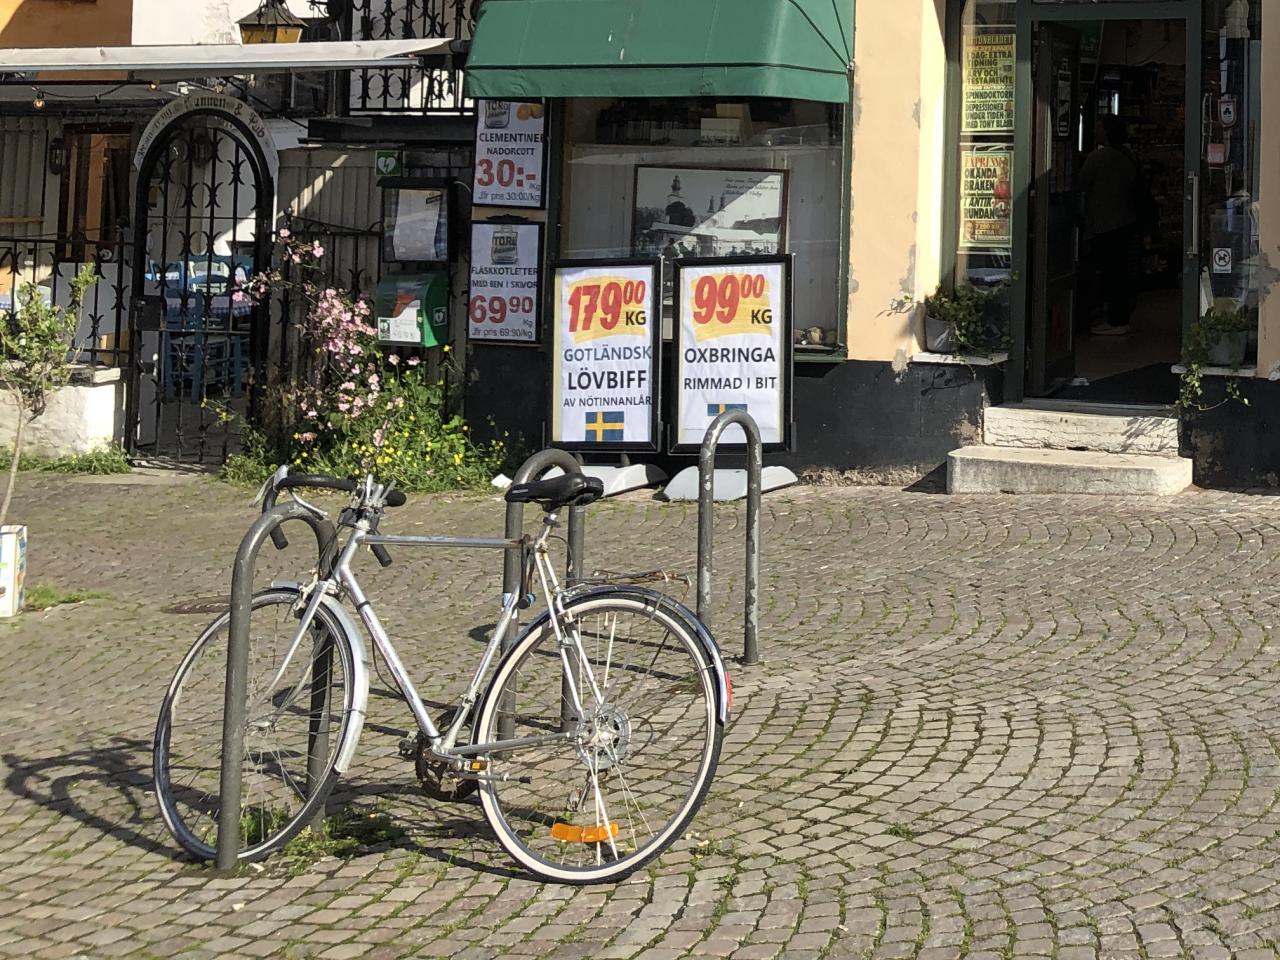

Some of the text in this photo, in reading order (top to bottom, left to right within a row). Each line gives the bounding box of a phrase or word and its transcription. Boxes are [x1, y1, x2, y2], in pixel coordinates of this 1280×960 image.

[989, 50, 1013, 59] EXTRA
[984, 69, 999, 77] OCH
[965, 111, 986, 120] UNDER
[979, 120, 995, 128] TONY
[486, 147, 536, 155] NADORCOTT
[477, 158, 537, 187] 30:-
[490, 280, 503, 288] BEN
[625, 310, 647, 325] KG
[750, 309, 773, 324] KG
[564, 344, 652, 362] GOTLÄNDSK
[684, 347, 776, 363] OXBRINGA
[568, 367, 647, 390] LÖVBIFF
[683, 377, 777, 389] RIMMAD I BIT
[563, 398, 576, 407] AV
